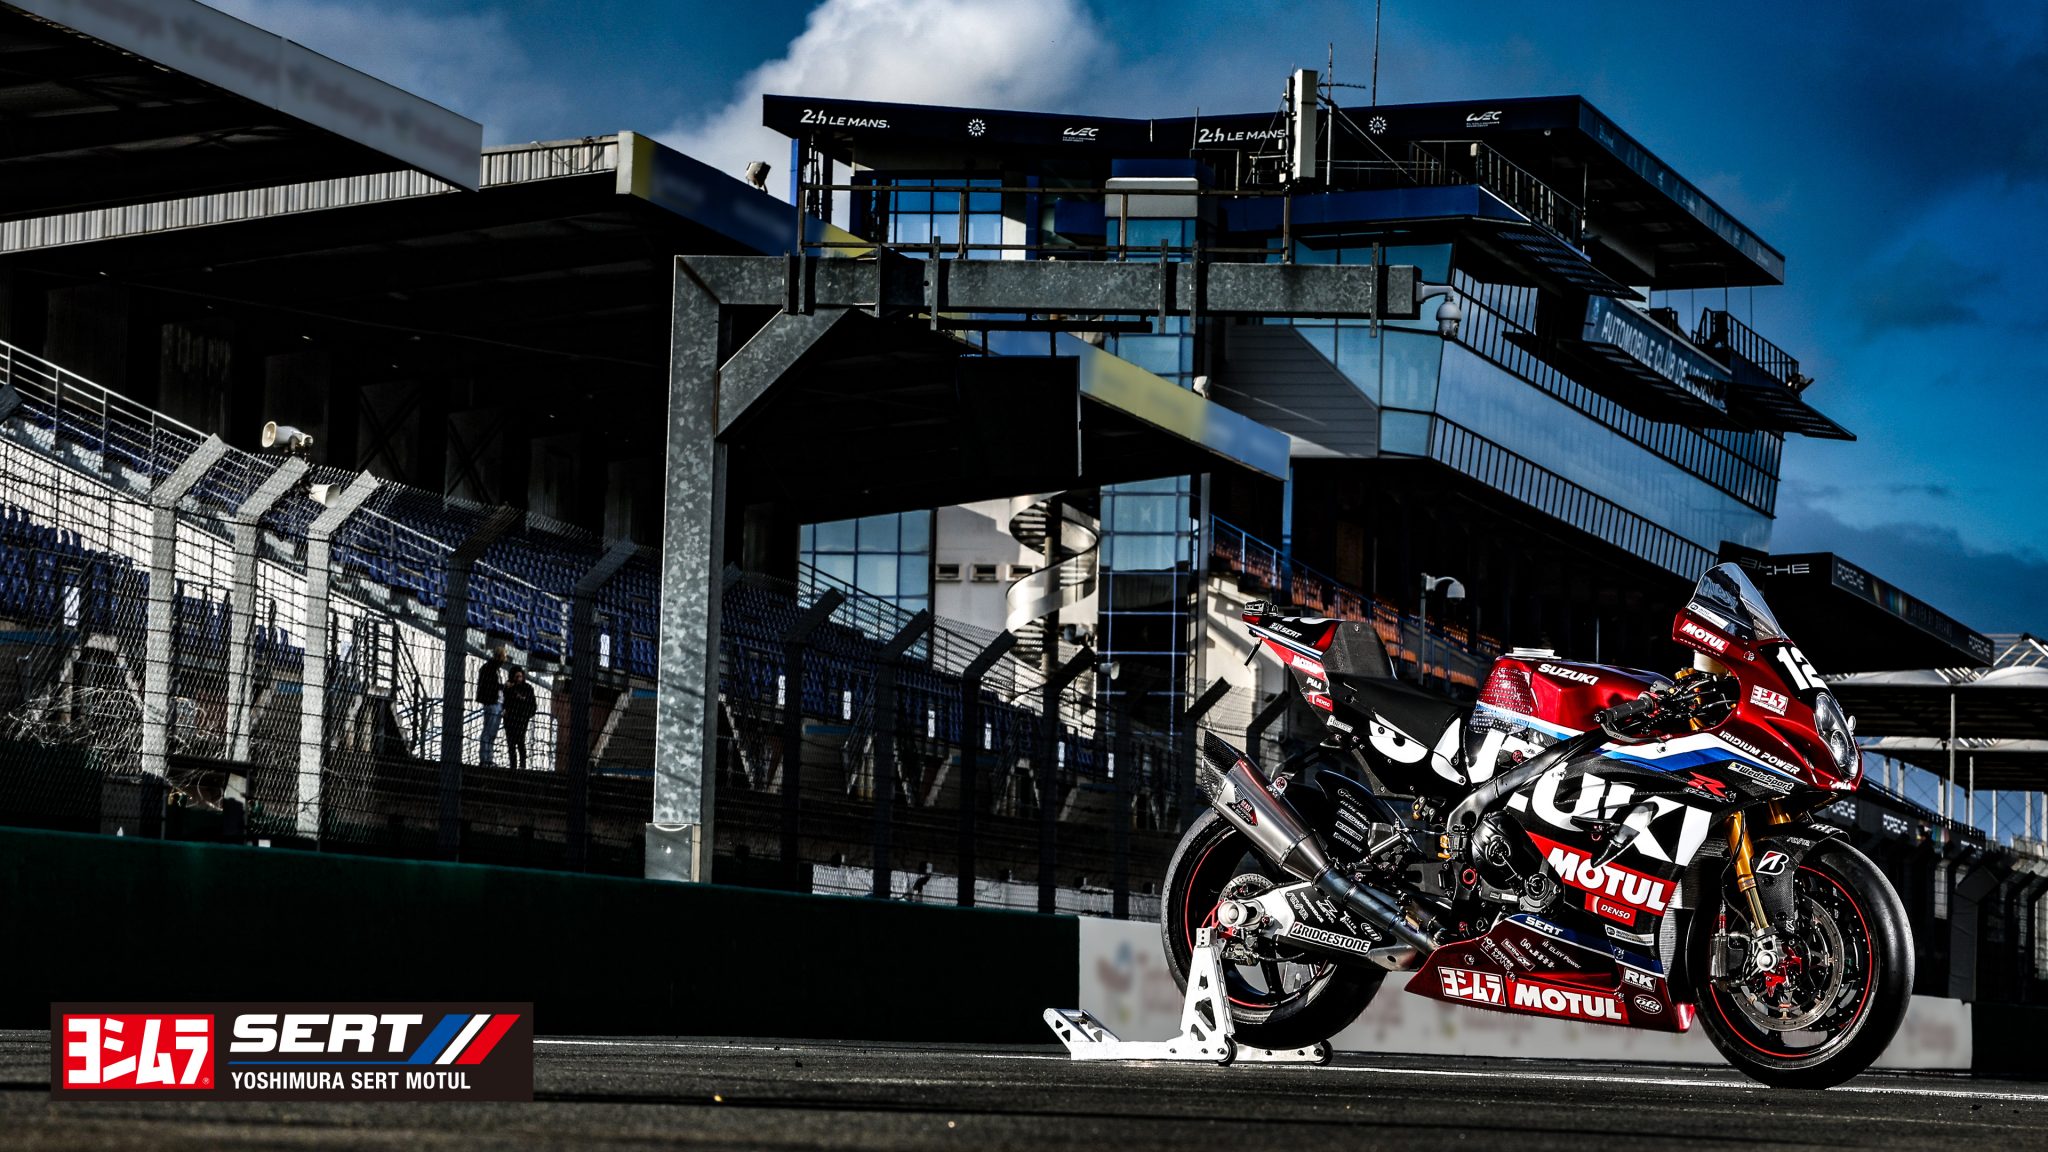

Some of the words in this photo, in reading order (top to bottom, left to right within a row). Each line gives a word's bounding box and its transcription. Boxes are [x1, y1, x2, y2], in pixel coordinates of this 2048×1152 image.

[829, 116, 847, 126] LE
[1227, 131, 1245, 141] LE
[1246, 129, 1286, 140] MANS
[1601, 311, 1656, 367] AUTOMOBILE
[1654, 344, 1677, 380] CLUB
[1675, 356, 1688, 389] DE
[1682, 622, 1726, 651] MOTUL
[1538, 663, 1599, 686] SUZUKI
[1776, 646, 1829, 690] 12
[1316, 697, 1330, 708] DENSO
[1719, 731, 1761, 756] IRIDIUM
[1761, 751, 1800, 775] POWER
[1338, 808, 1368, 830] SPEEDWAY
[1548, 848, 1668, 913] MOTUL
[1300, 891, 1324, 923] GOODRIDGE
[1600, 903, 1631, 919] DENSO
[1291, 921, 1371, 952] BRIDGESTONE
[1525, 916, 1563, 936] SERT
[1481, 941, 1490, 952] LE
[1491, 951, 1512, 970] MANS
[1493, 947, 1514, 967] course
[1563, 955, 1582, 969] Power
[1441, 968, 1501, 1003] ヨシムラ
[1625, 969, 1654, 989] RK
[1514, 983, 1622, 1020] MOTUL
